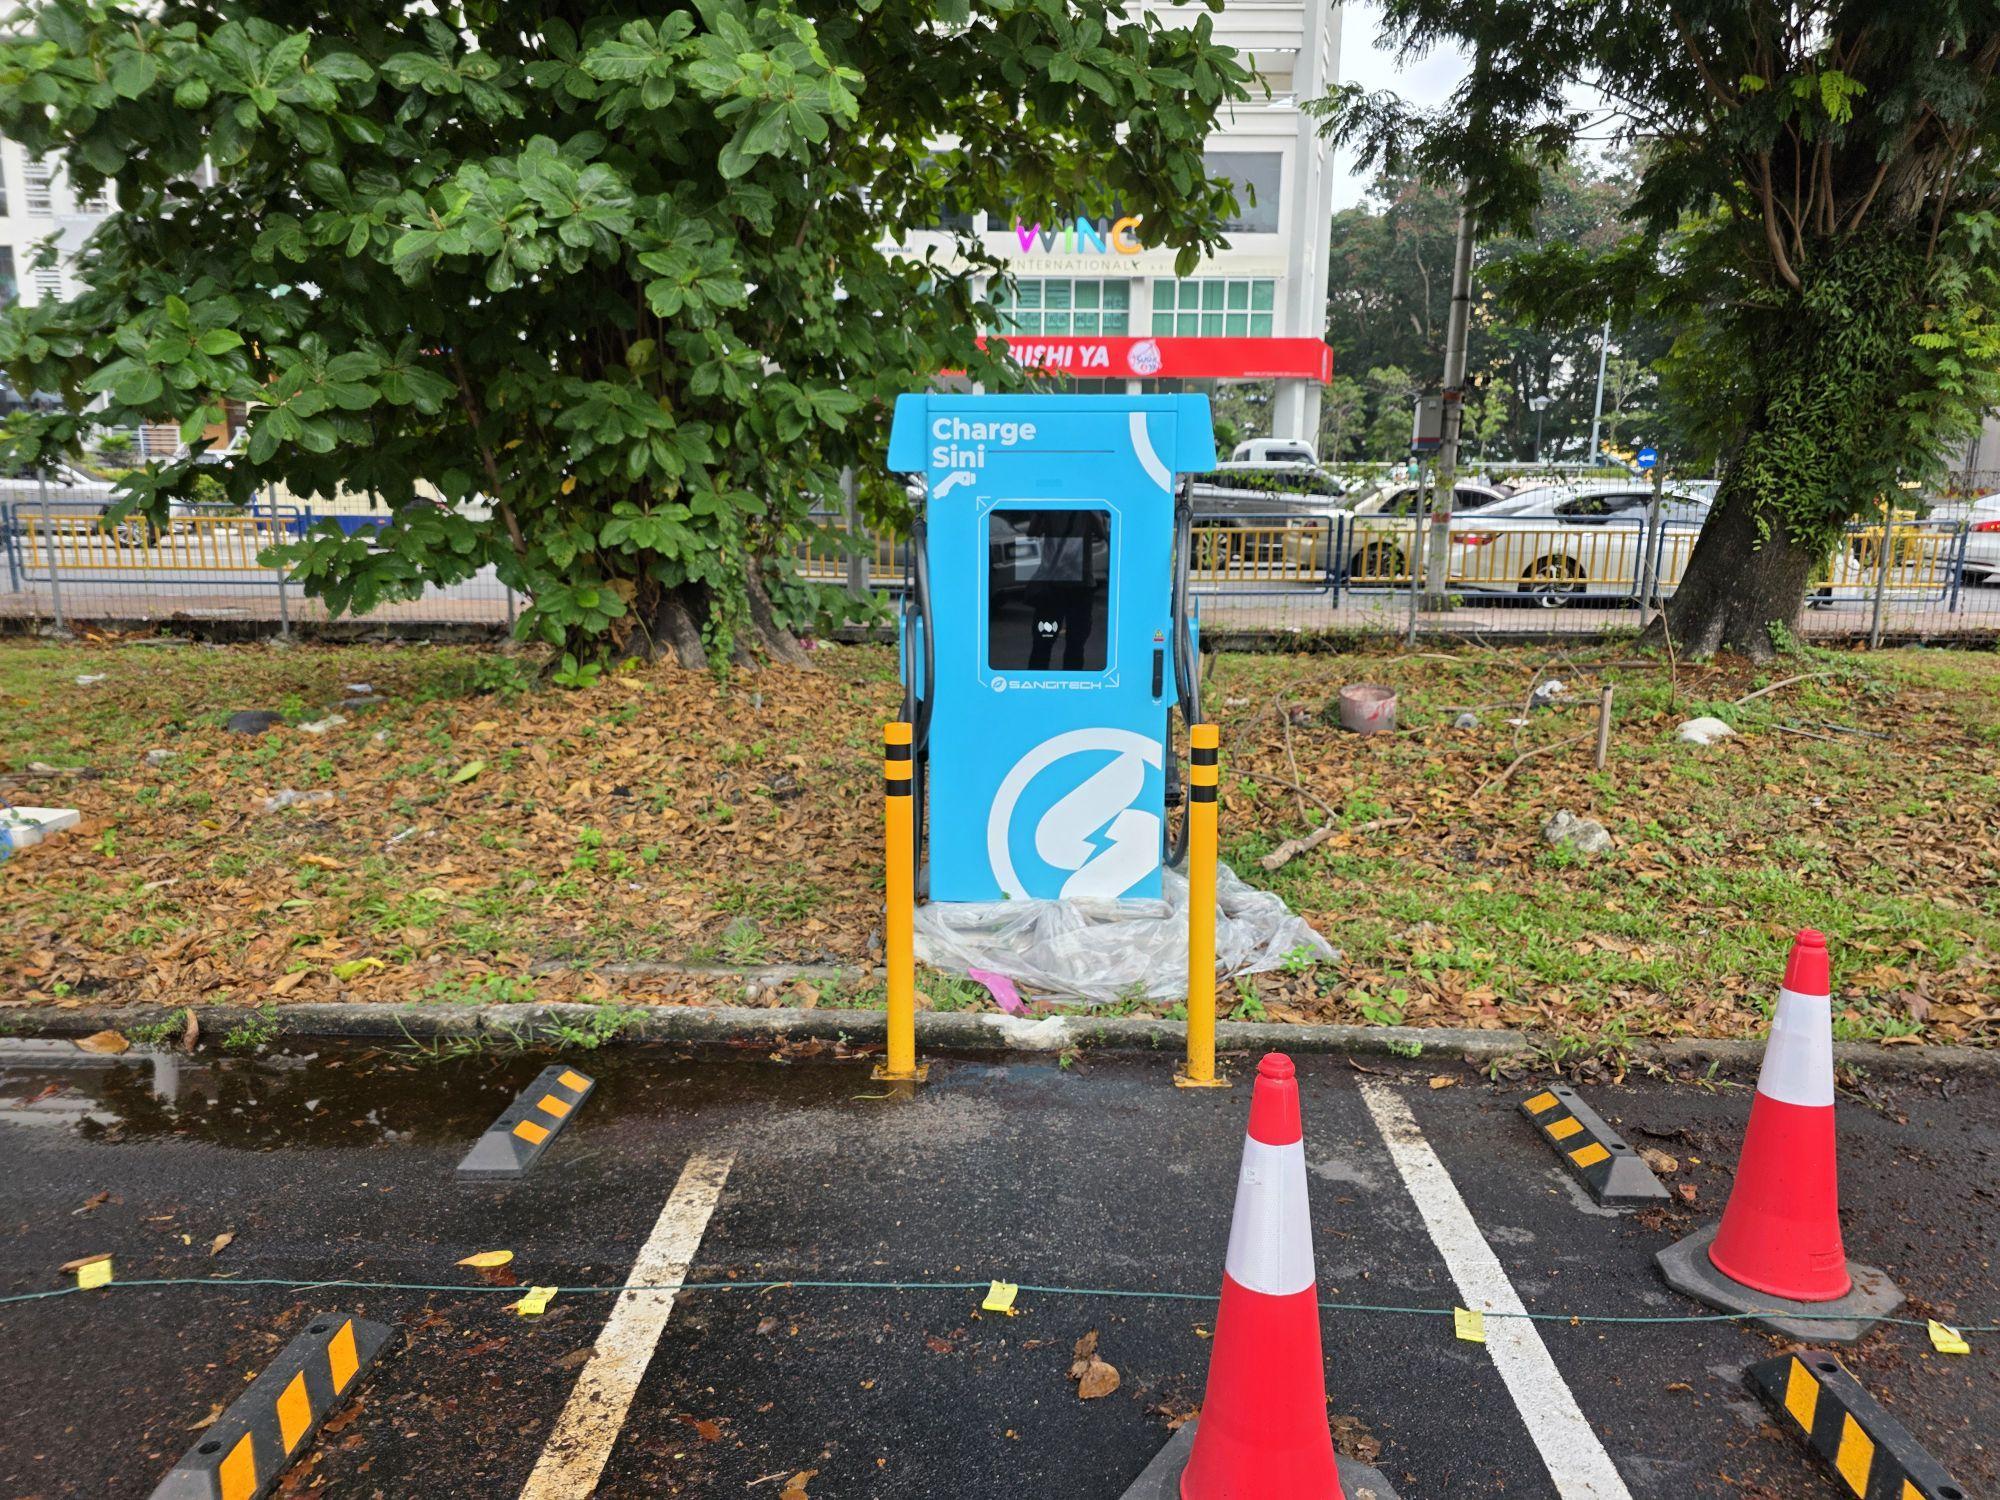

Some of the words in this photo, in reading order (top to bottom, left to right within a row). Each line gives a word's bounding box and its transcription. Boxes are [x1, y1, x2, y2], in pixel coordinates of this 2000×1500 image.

[1012, 260, 1134, 271] INTERNATIONAL
[1079, 345, 1110, 368] YA
[932, 417, 1037, 446] Charge
[932, 443, 985, 468] Sini
